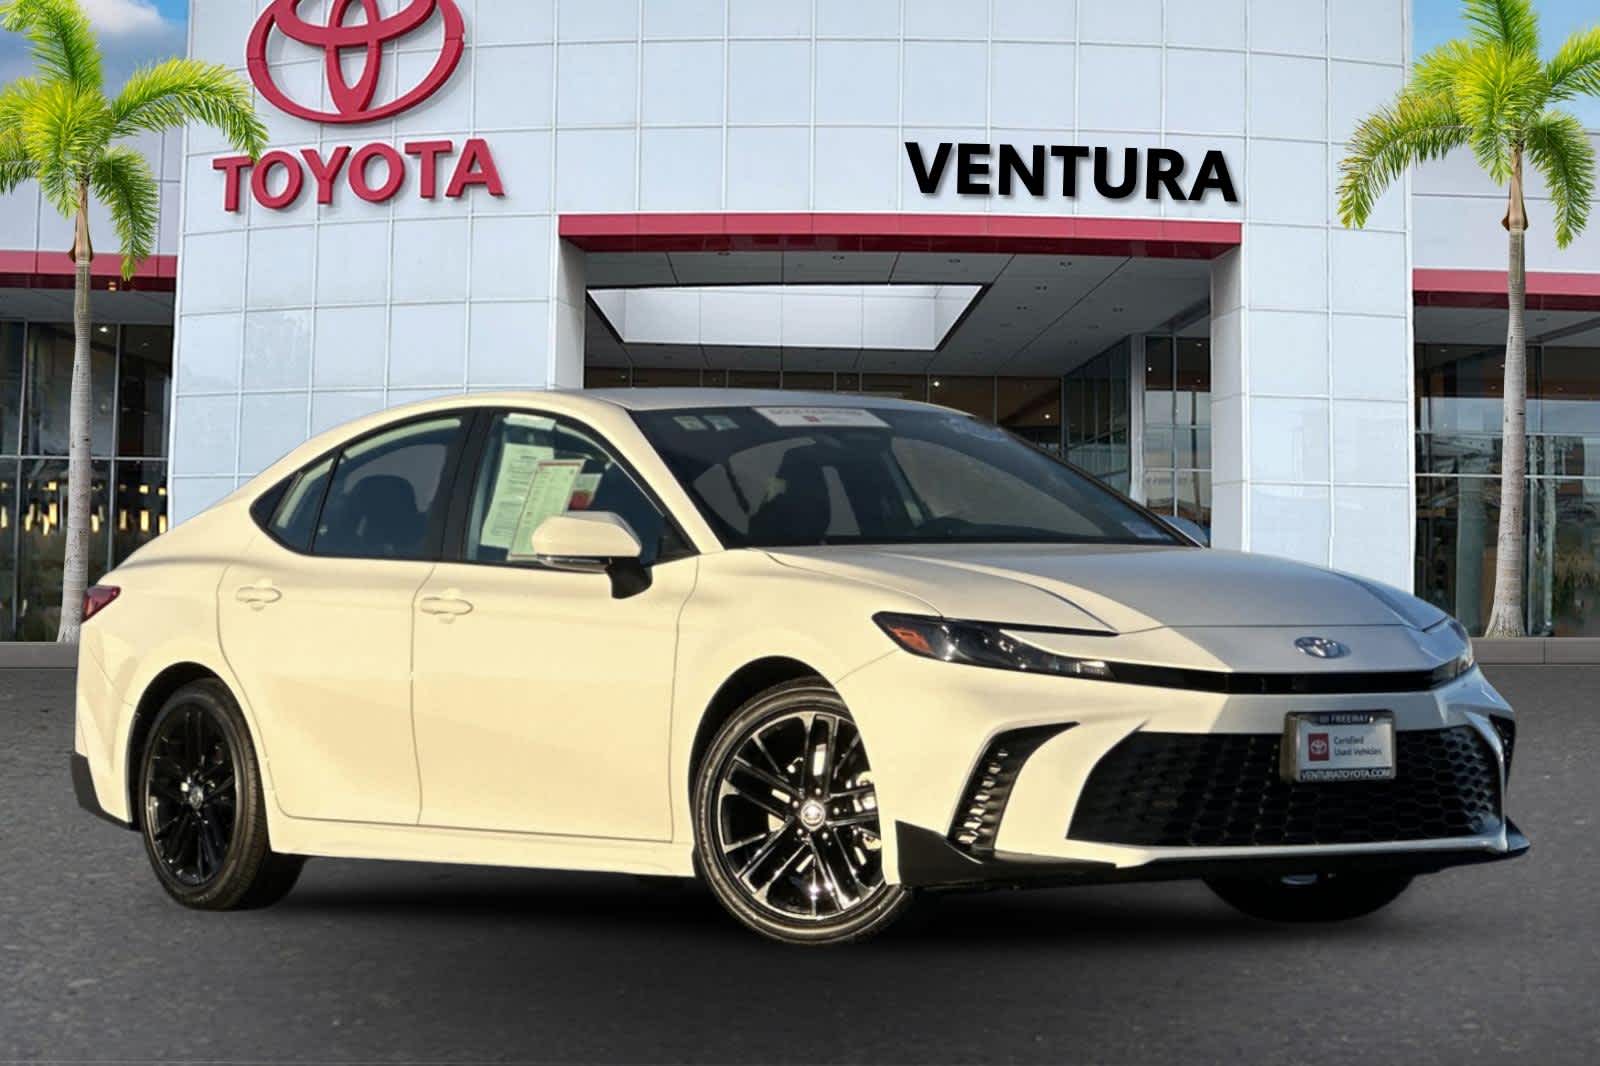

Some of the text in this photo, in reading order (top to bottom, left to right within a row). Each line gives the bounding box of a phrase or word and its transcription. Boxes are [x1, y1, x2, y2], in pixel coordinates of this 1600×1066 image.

[212, 139, 505, 212] TOYOTA
[904, 142, 1239, 203] VENTURA
[1333, 735, 1364, 745] Certified
